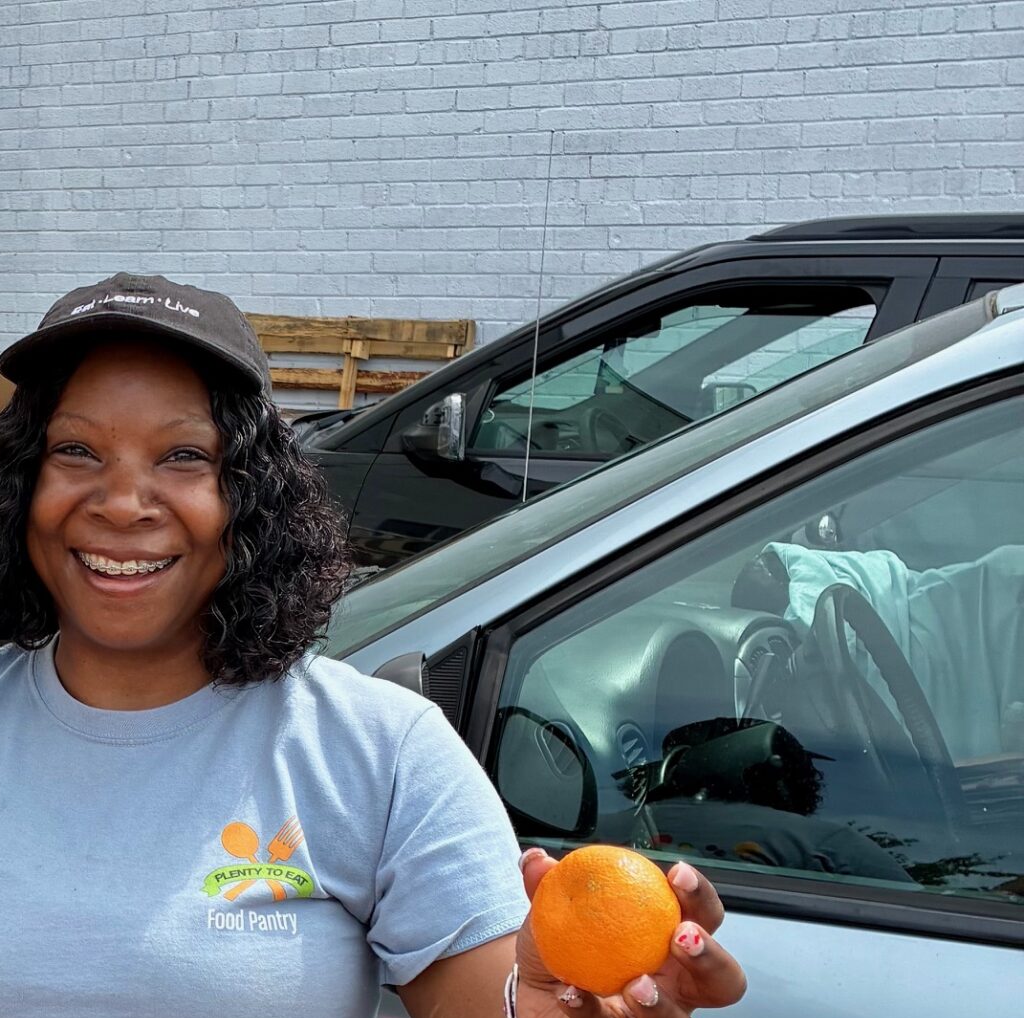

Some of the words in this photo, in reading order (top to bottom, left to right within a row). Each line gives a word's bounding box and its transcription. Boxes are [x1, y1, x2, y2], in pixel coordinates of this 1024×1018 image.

[103, 294, 155, 304] Learn
[164, 297, 200, 318] Live
[214, 867, 263, 883] PLENTY
[266, 867, 283, 877] TO
[285, 870, 309, 887] EAT
[207, 909, 245, 931] Food
[248, 910, 297, 935] Pantry
